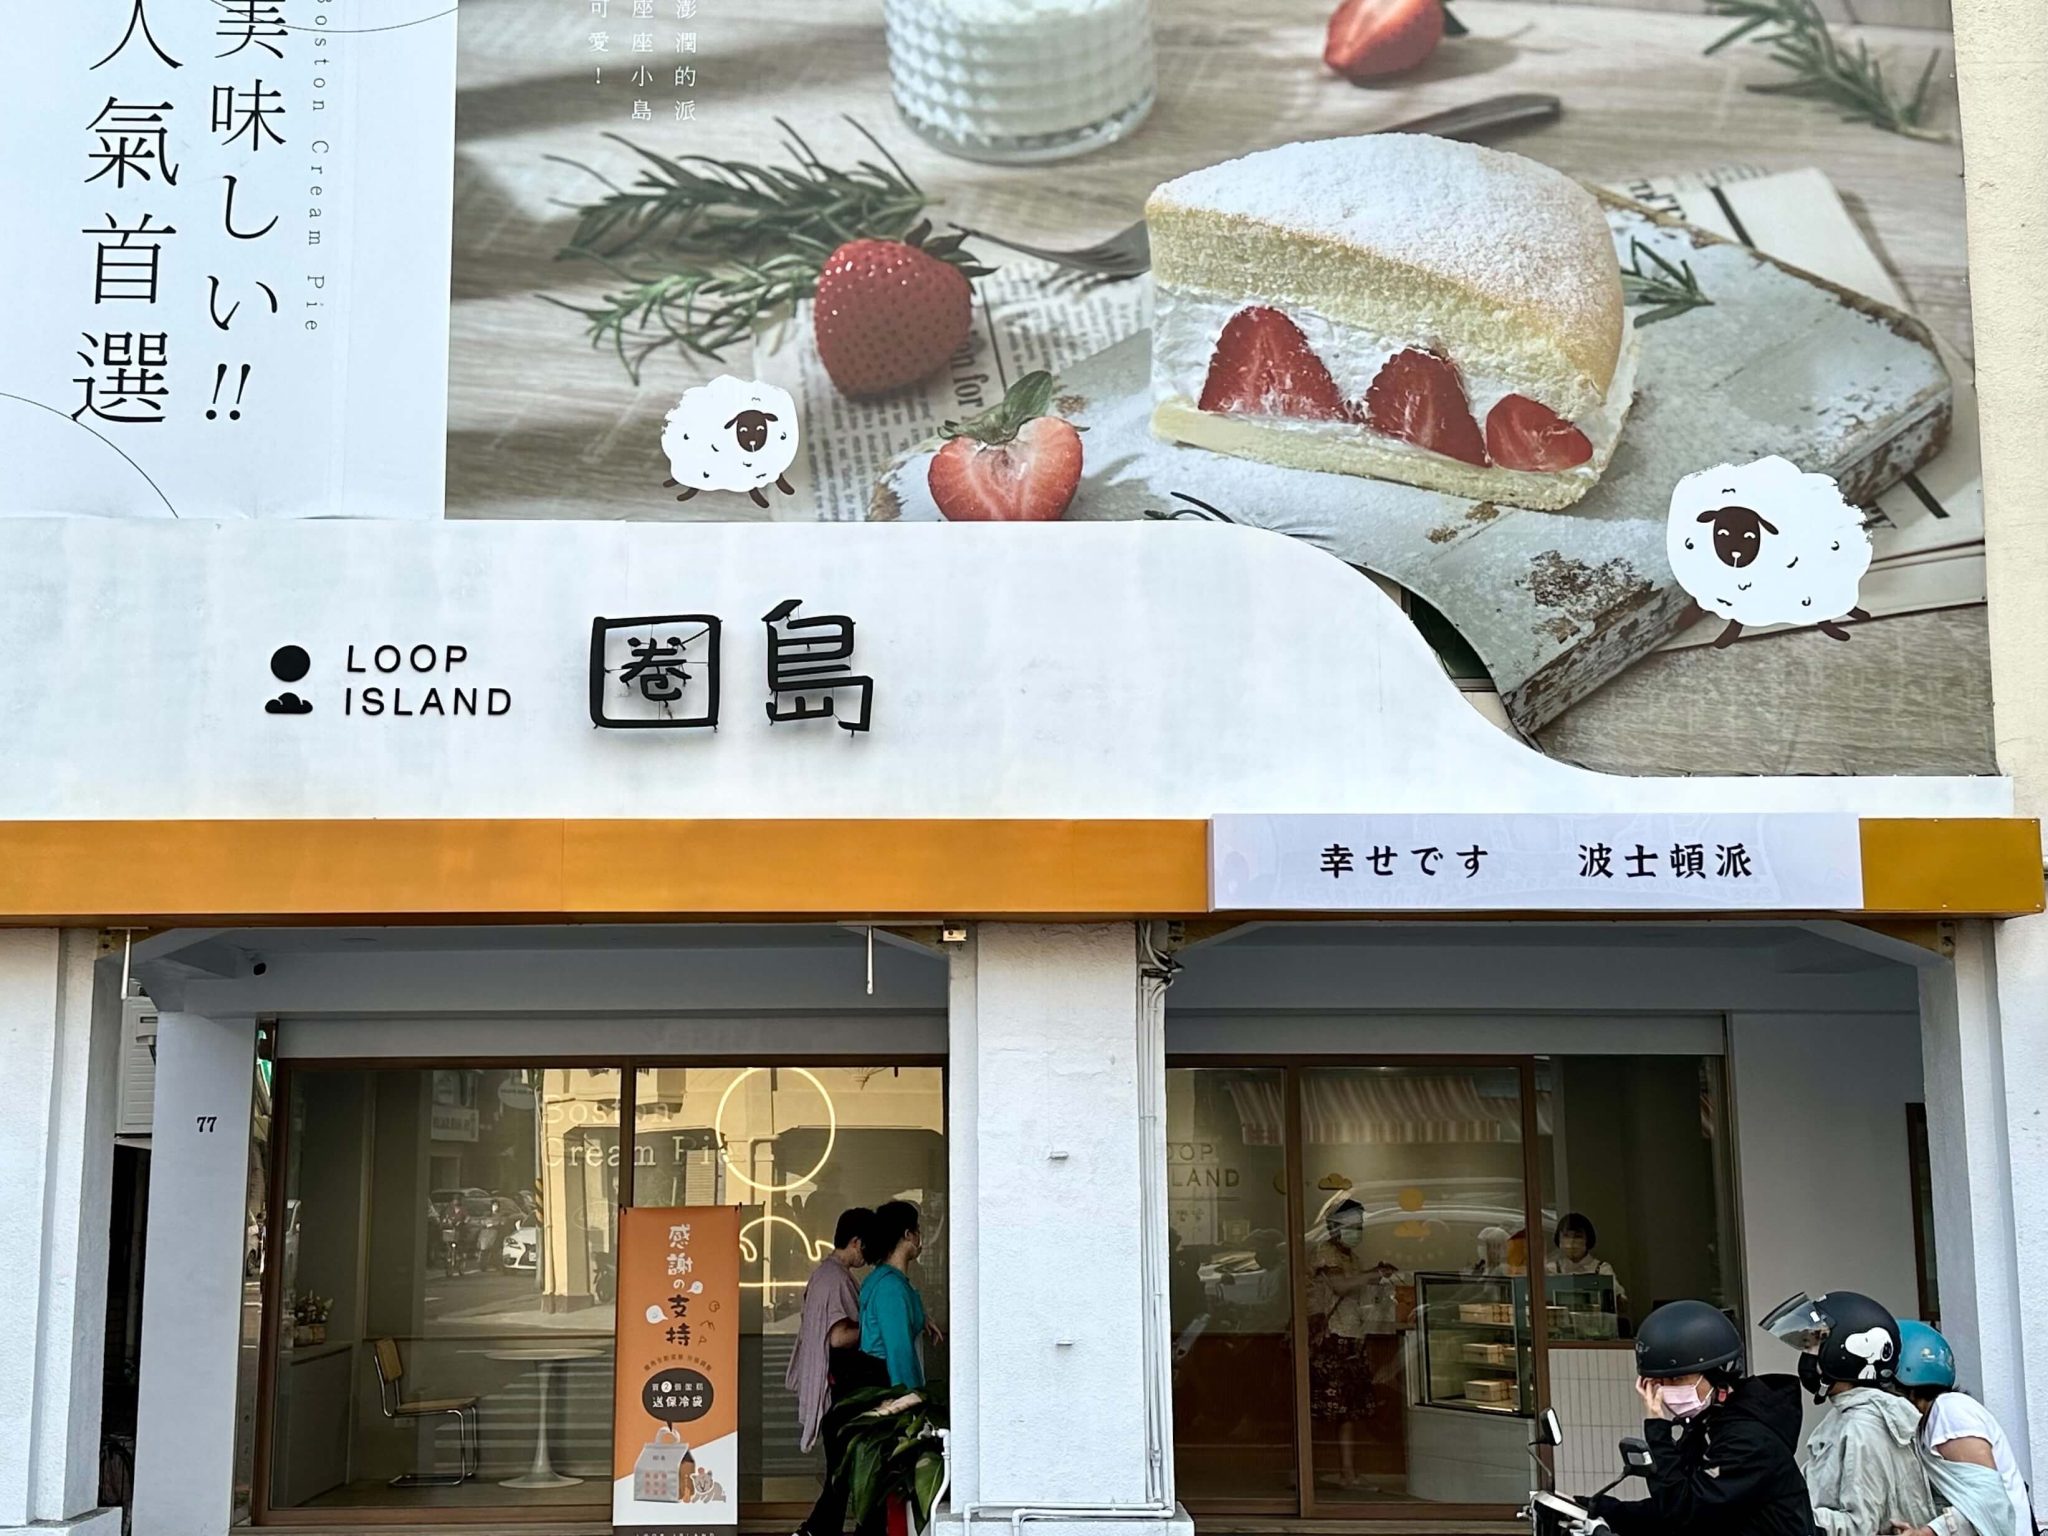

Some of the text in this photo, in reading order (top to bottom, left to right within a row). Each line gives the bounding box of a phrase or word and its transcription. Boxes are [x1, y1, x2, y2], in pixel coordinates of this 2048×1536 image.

[631, 0, 654, 121] 座座小島
[304, 0, 332, 332] oston Cream Pie
[71, 0, 184, 423] 人氣首選
[952, 373, 989, 408] for
[346, 644, 468, 673] LOOP
[589, 599, 874, 736] 圈島
[344, 687, 512, 716] ISLAND
[1319, 843, 1754, 879] 幸せです 波士頓派
[196, 1116, 218, 1133] 77
[545, 1136, 657, 1168] Cream
[665, 1223, 694, 1347] 感謝の支持
[652, 1395, 704, 1409] 送保冷袋
